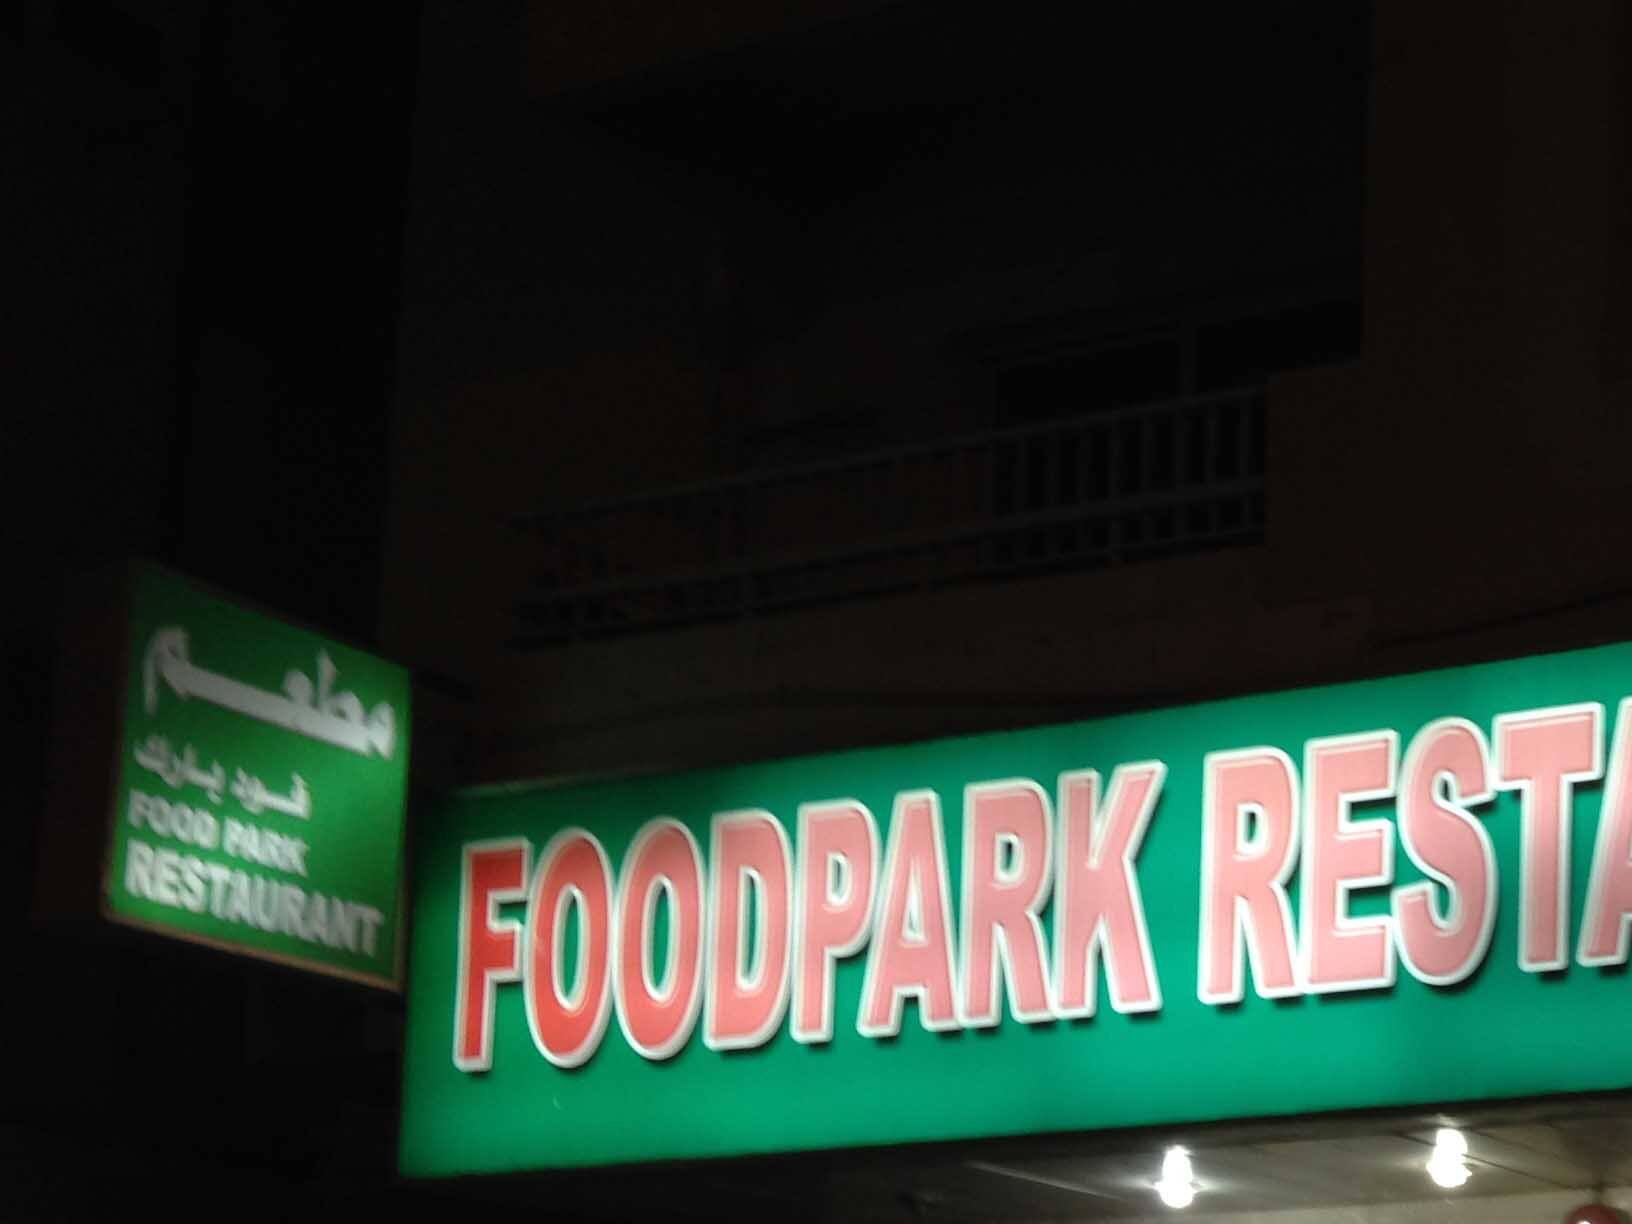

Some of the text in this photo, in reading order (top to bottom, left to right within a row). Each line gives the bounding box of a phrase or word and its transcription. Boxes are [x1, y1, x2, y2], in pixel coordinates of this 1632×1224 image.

[143, 626, 396, 761] مطعم
[128, 788, 312, 878] FOOD PARK
[124, 839, 384, 957] RESTAURANT
[454, 760, 1167, 1072] FOODPARK
